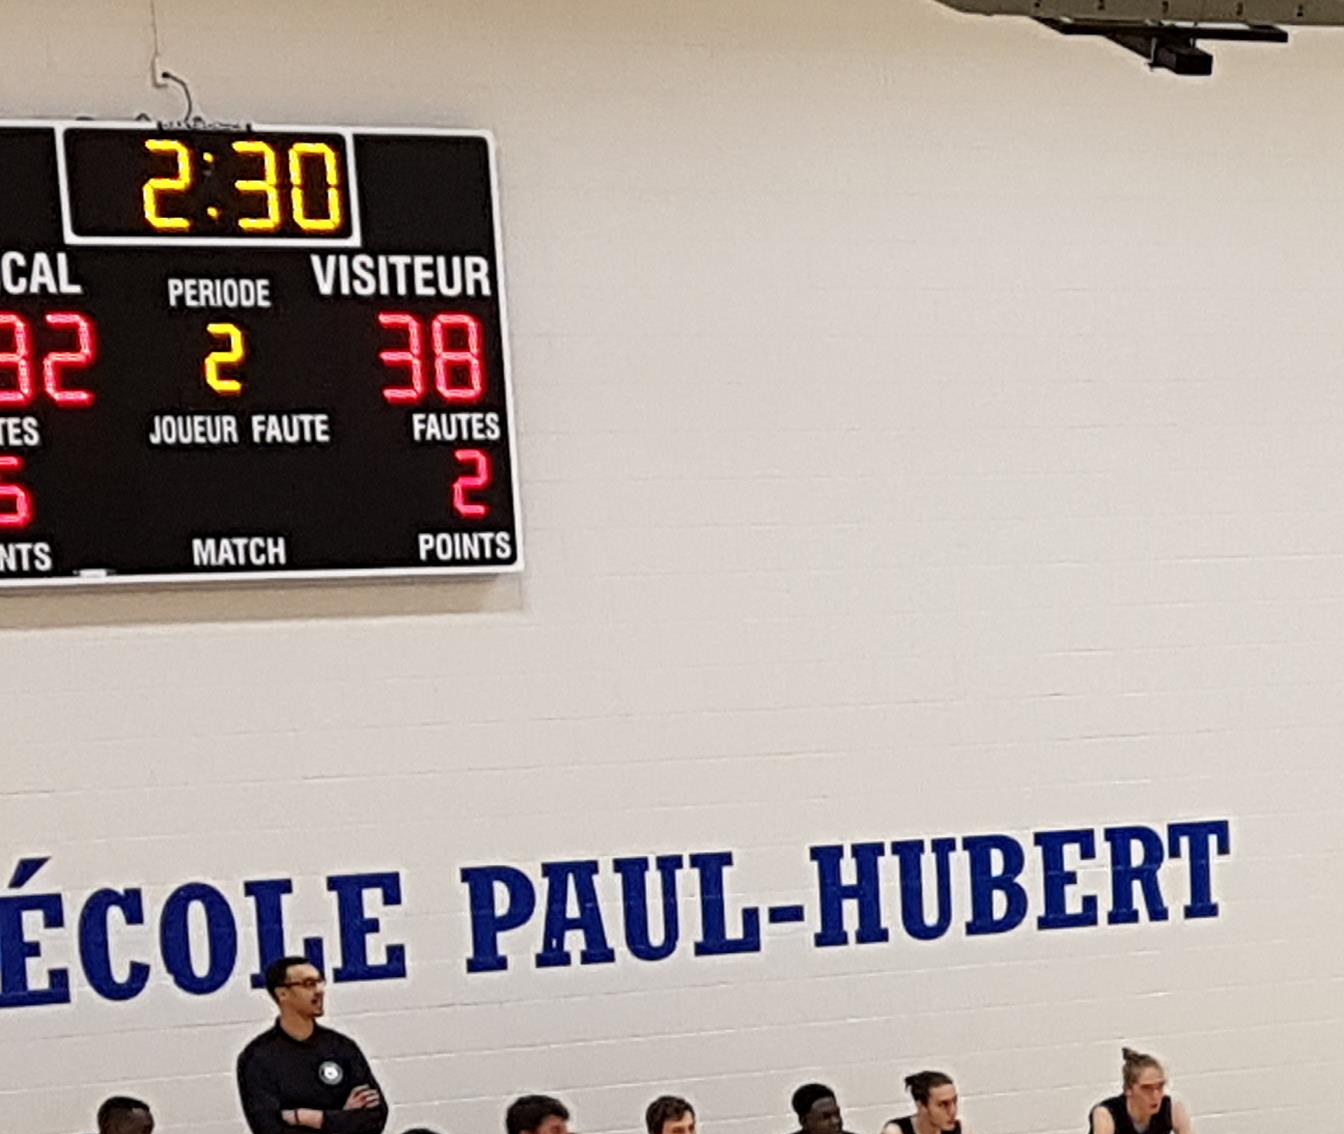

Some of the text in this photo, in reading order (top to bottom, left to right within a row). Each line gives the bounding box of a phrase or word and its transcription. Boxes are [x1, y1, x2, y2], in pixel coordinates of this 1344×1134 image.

[142, 138, 342, 232] 2:30
[168, 278, 272, 308] PERIODE
[310, 254, 493, 297] VISITEUR
[203, 322, 245, 395] 2
[377, 312, 487, 402] 38
[149, 414, 330, 445] JOUEUR FAUTE
[413, 412, 501, 441] FAUTES
[452, 447, 493, 519] 2
[192, 537, 287, 566] MATCH
[418, 531, 512, 561] POINTS
[0, 820, 1231, 1008] ÉCOLE PAUL-HUBERT
